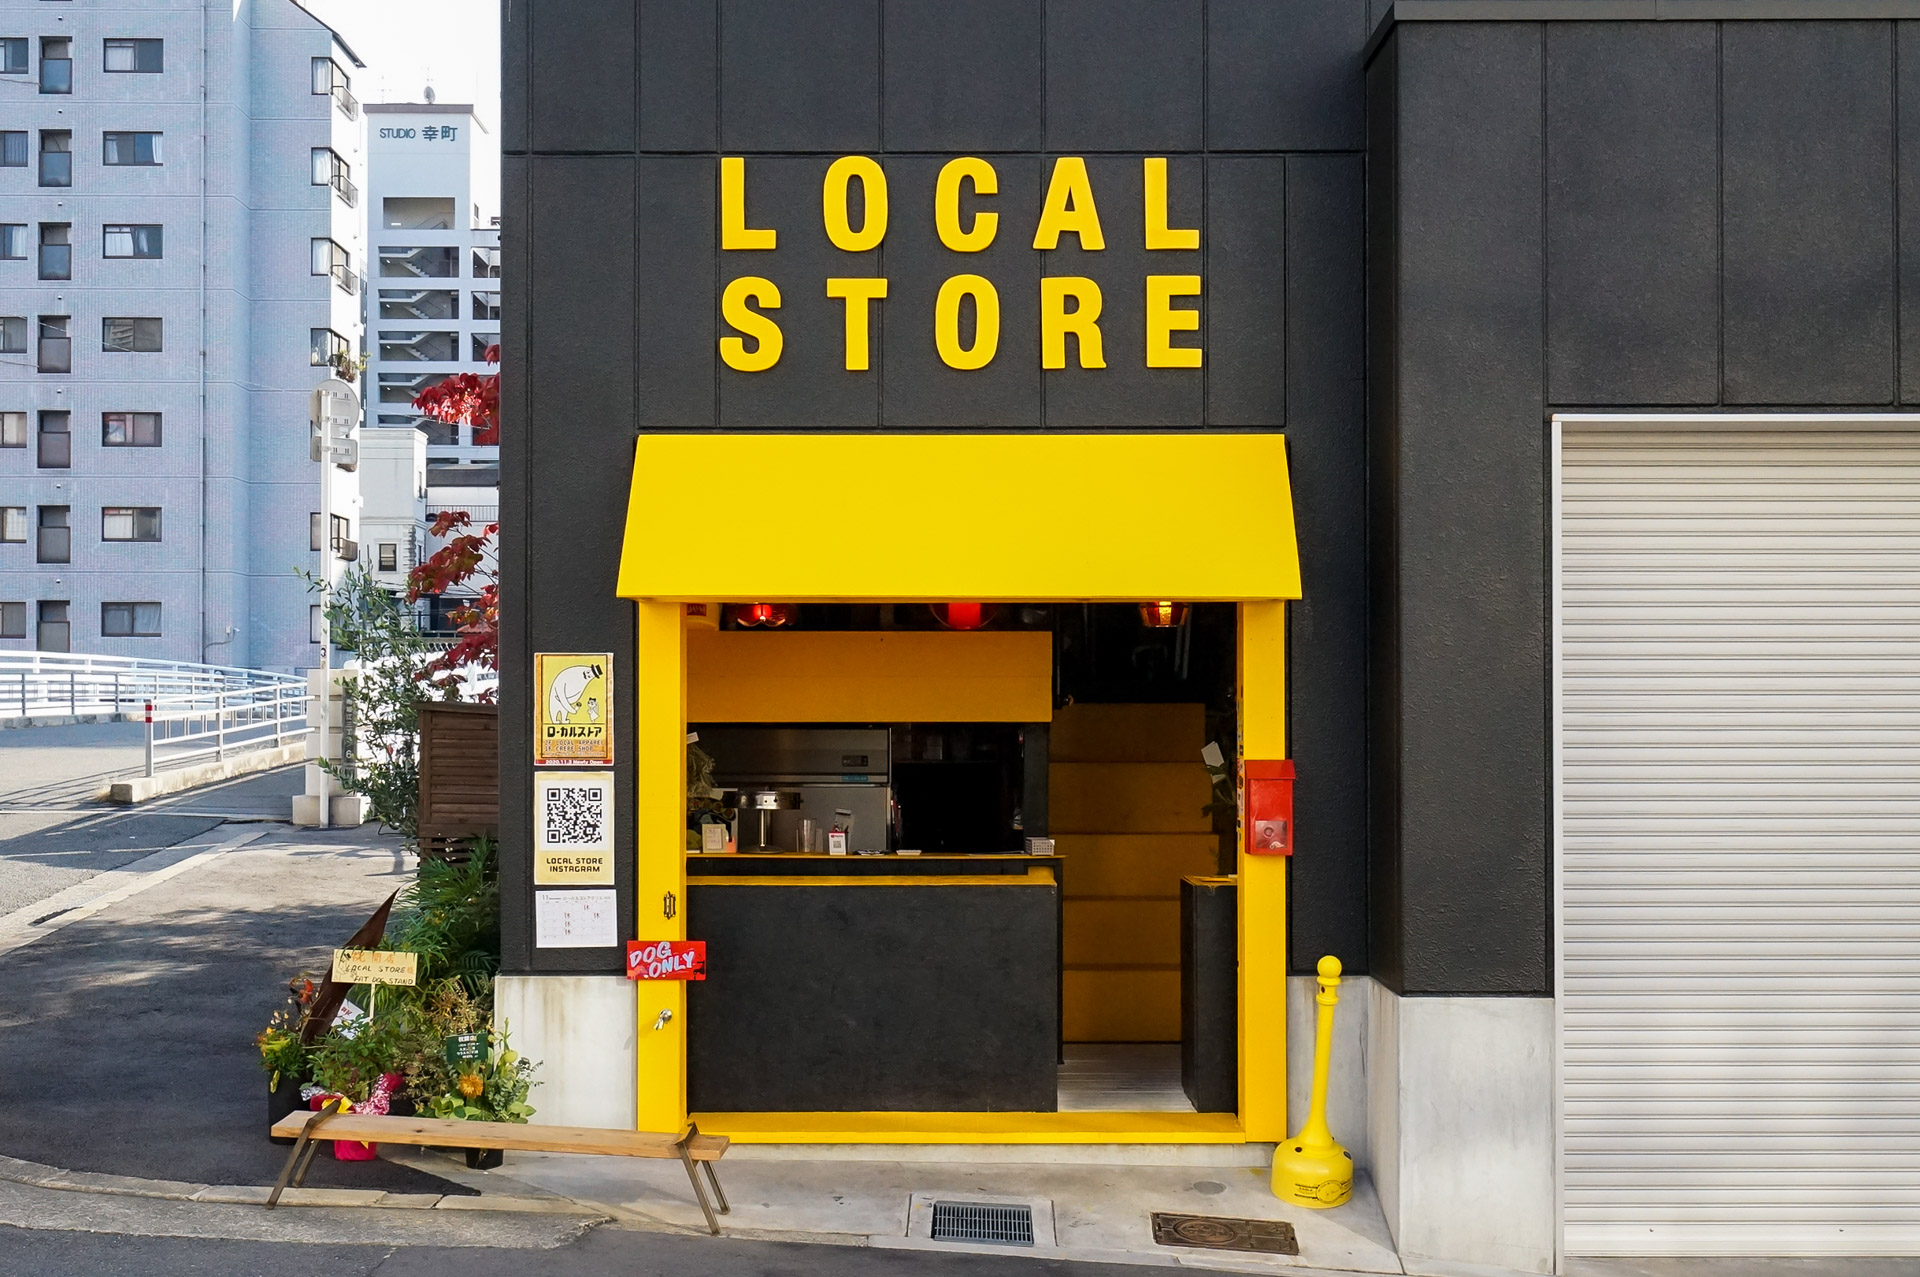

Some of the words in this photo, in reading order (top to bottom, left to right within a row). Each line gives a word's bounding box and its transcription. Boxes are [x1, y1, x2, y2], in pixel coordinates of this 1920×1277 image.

[379, 128, 416, 139] STUDIO
[421, 125, 458, 142] 幸町
[720, 155, 1200, 252] LOCAL
[719, 274, 1203, 372] STORE
[546, 857, 573, 865] LOCAL
[575, 857, 604, 865] STORE
[549, 865, 601, 873] INSTAGRAM
[629, 941, 672, 968] DOG
[378, 965, 406, 974] STORE
[648, 951, 695, 978] ONLY
[389, 977, 414, 986] STAND
